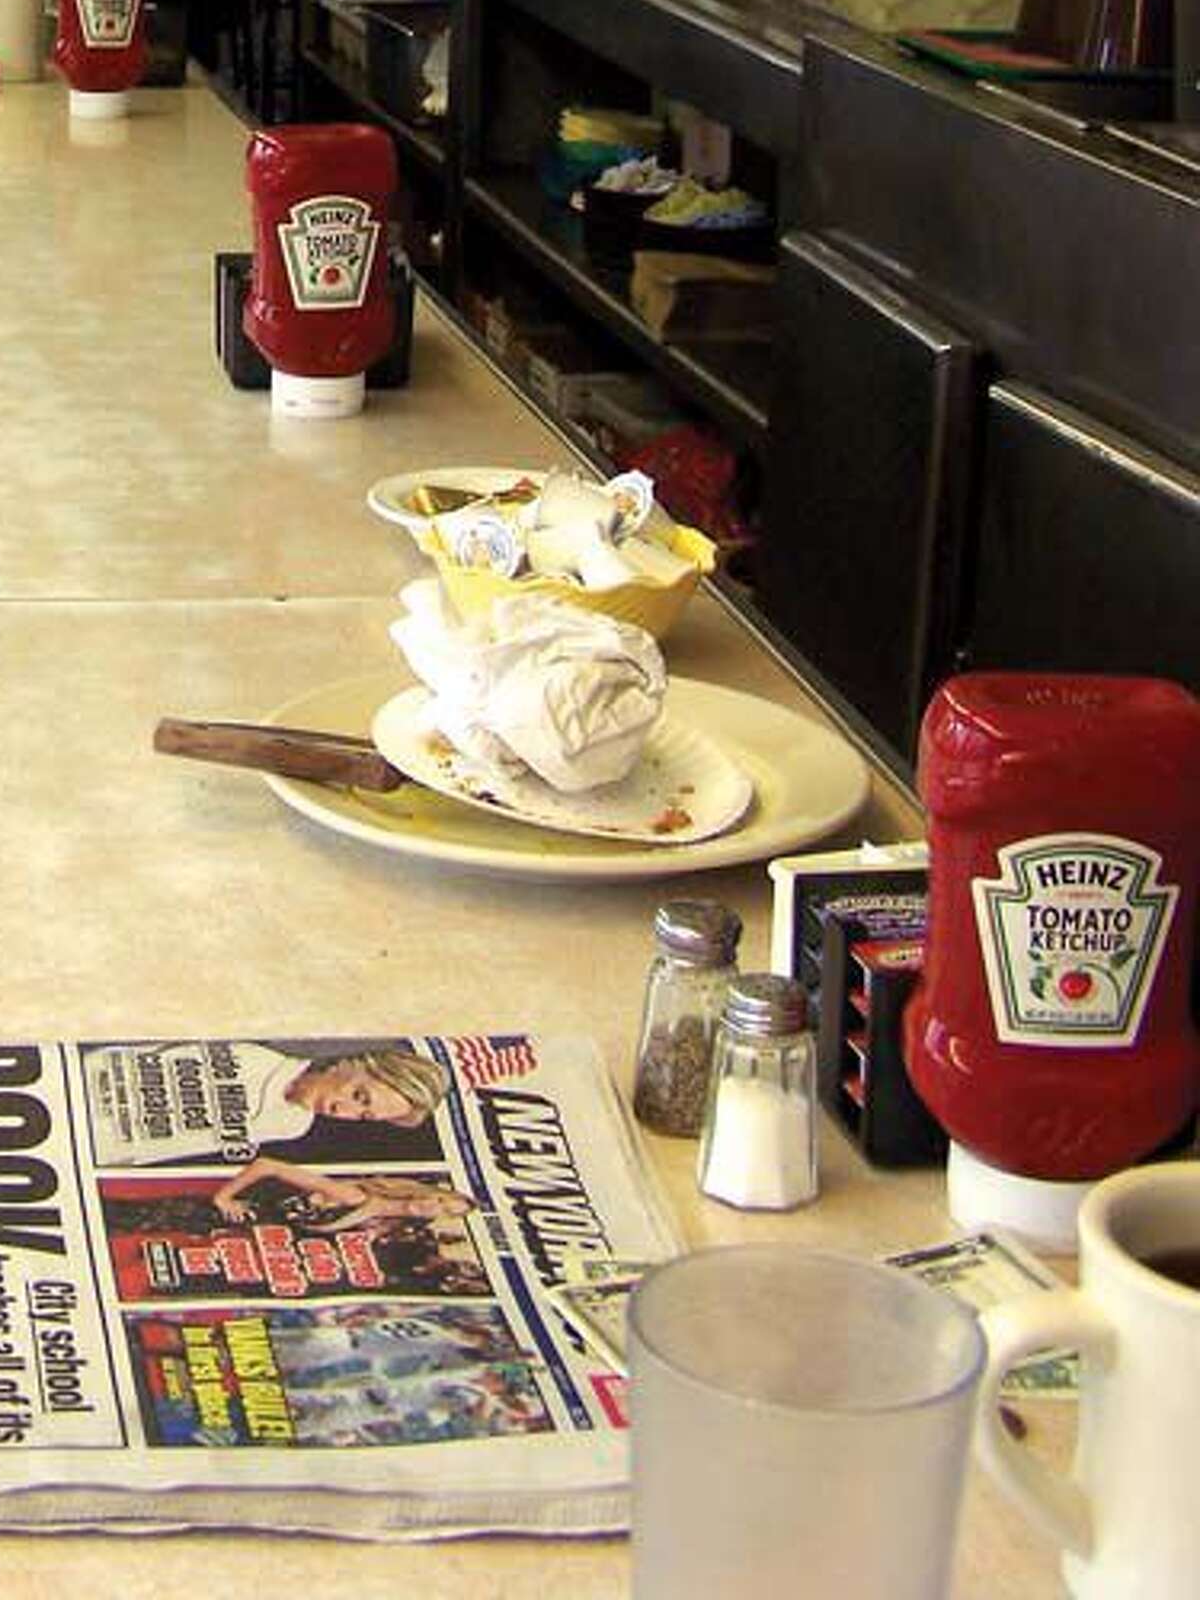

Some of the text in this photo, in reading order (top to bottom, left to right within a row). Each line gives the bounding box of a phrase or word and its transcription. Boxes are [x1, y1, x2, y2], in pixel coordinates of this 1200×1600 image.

[310, 211, 356, 226] HEINZ
[1036, 860, 1129, 891] HEINZ
[1026, 905, 1133, 932] TOMATO
[1029, 930, 1128, 951] KETCHUP
[137, 1053, 174, 1139] campaign
[28, 1280, 95, 1413] City school
